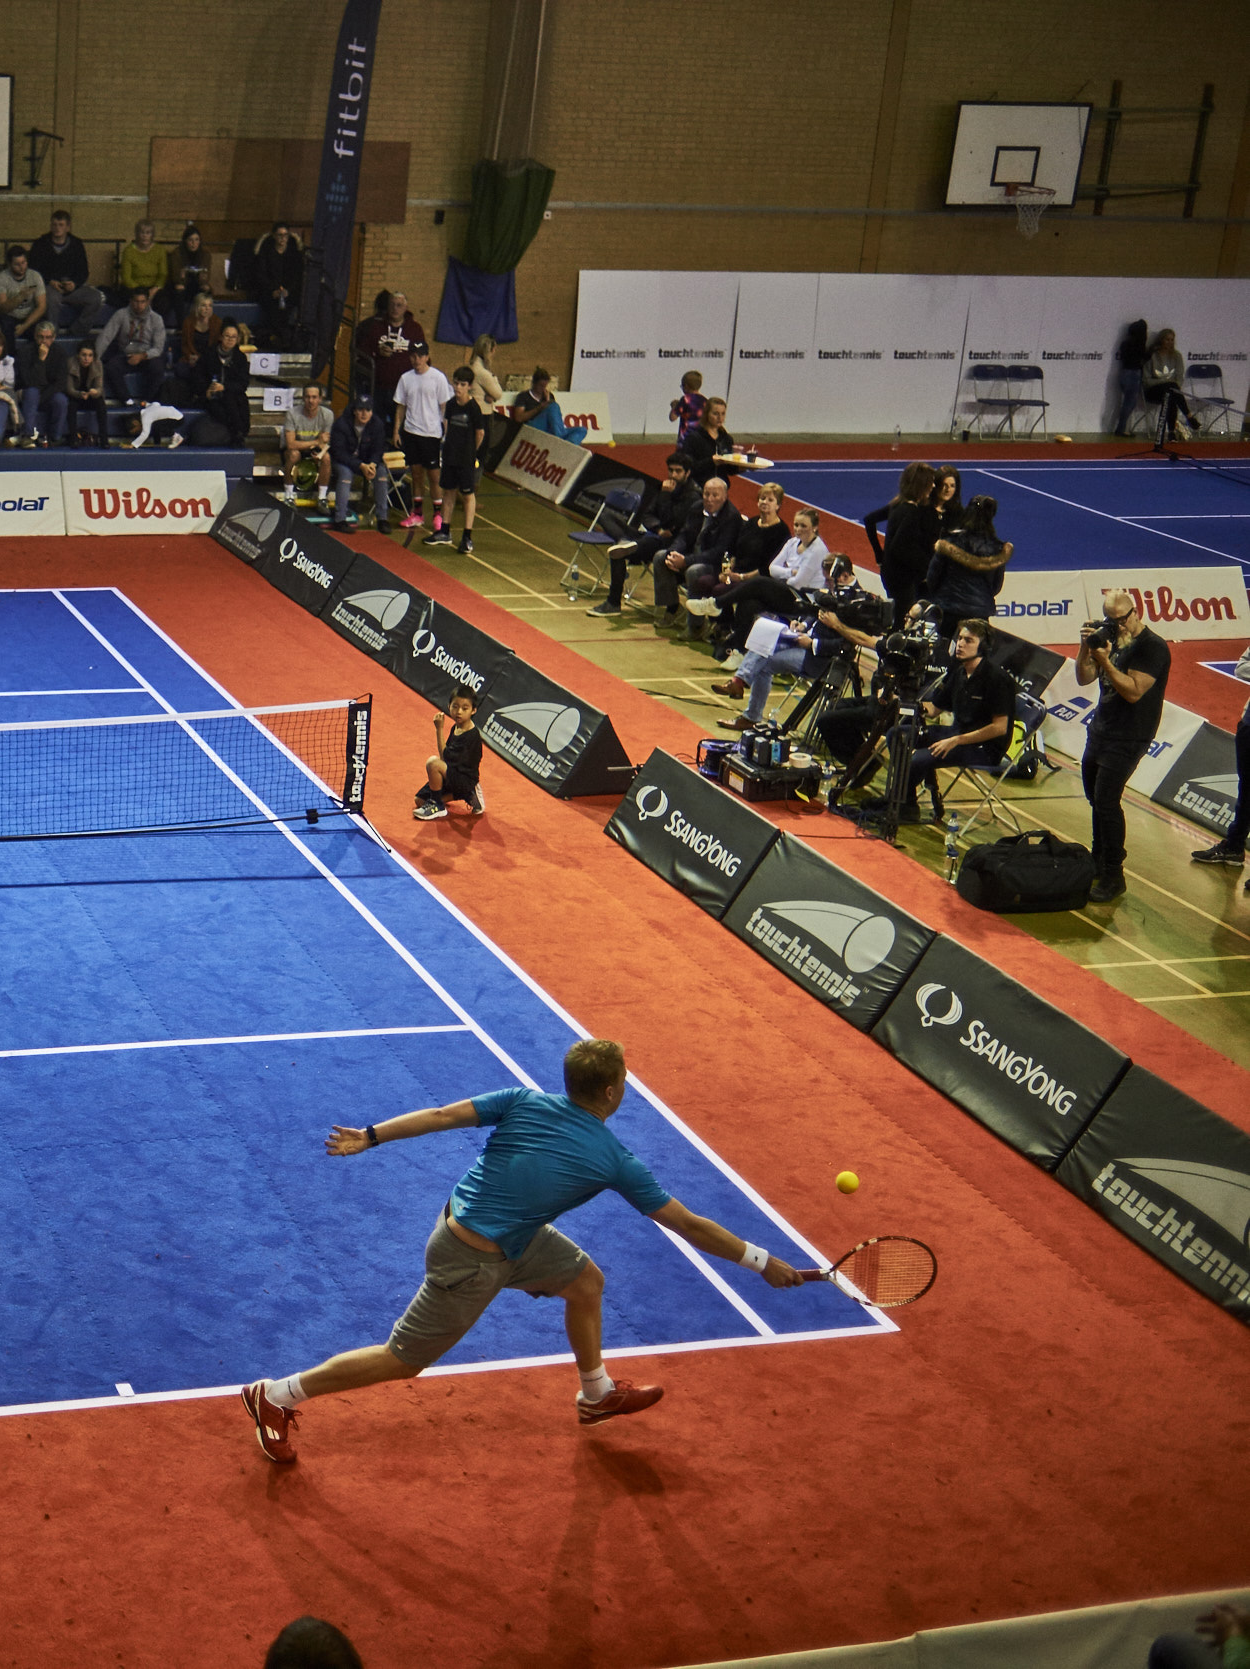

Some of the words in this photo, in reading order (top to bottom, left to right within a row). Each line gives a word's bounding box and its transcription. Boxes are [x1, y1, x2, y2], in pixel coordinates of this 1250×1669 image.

[334, 37, 366, 158] fitbit
[260, 358, 269, 369] C
[274, 396, 282, 406] B
[510, 439, 567, 487] Wilson
[80, 488, 214, 520] Wilson
[331, 602, 389, 651] touchtennis
[430, 646, 485, 693] SSANGYONG
[1054, 706, 1076, 720] PLAY
[482, 713, 555, 779] touchtennis
[664, 810, 742, 877] SSANGYONG
[745, 907, 861, 1007] touchtennis
[959, 1020, 1078, 1116] SSANGYONG
[1092, 1162, 1250, 1306] touchtenni
